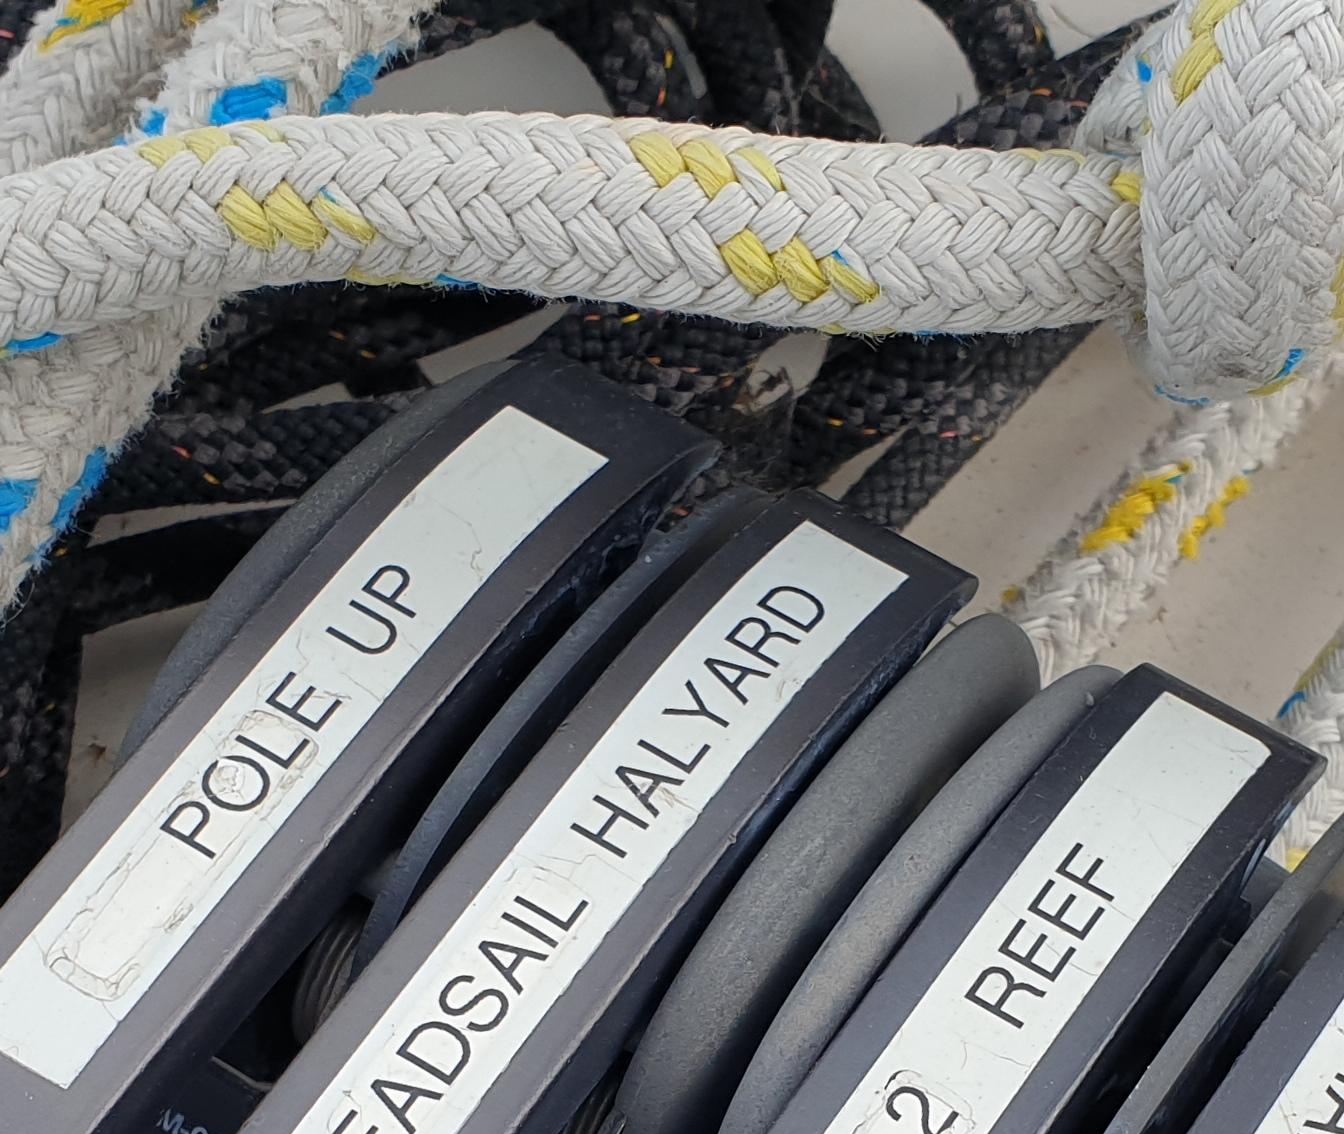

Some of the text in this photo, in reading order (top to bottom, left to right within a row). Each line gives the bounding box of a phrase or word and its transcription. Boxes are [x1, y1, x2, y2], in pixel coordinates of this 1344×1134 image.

[159, 564, 418, 859] POLE UP
[569, 584, 826, 859] HALYARD
[964, 842, 1116, 1029] REEF
